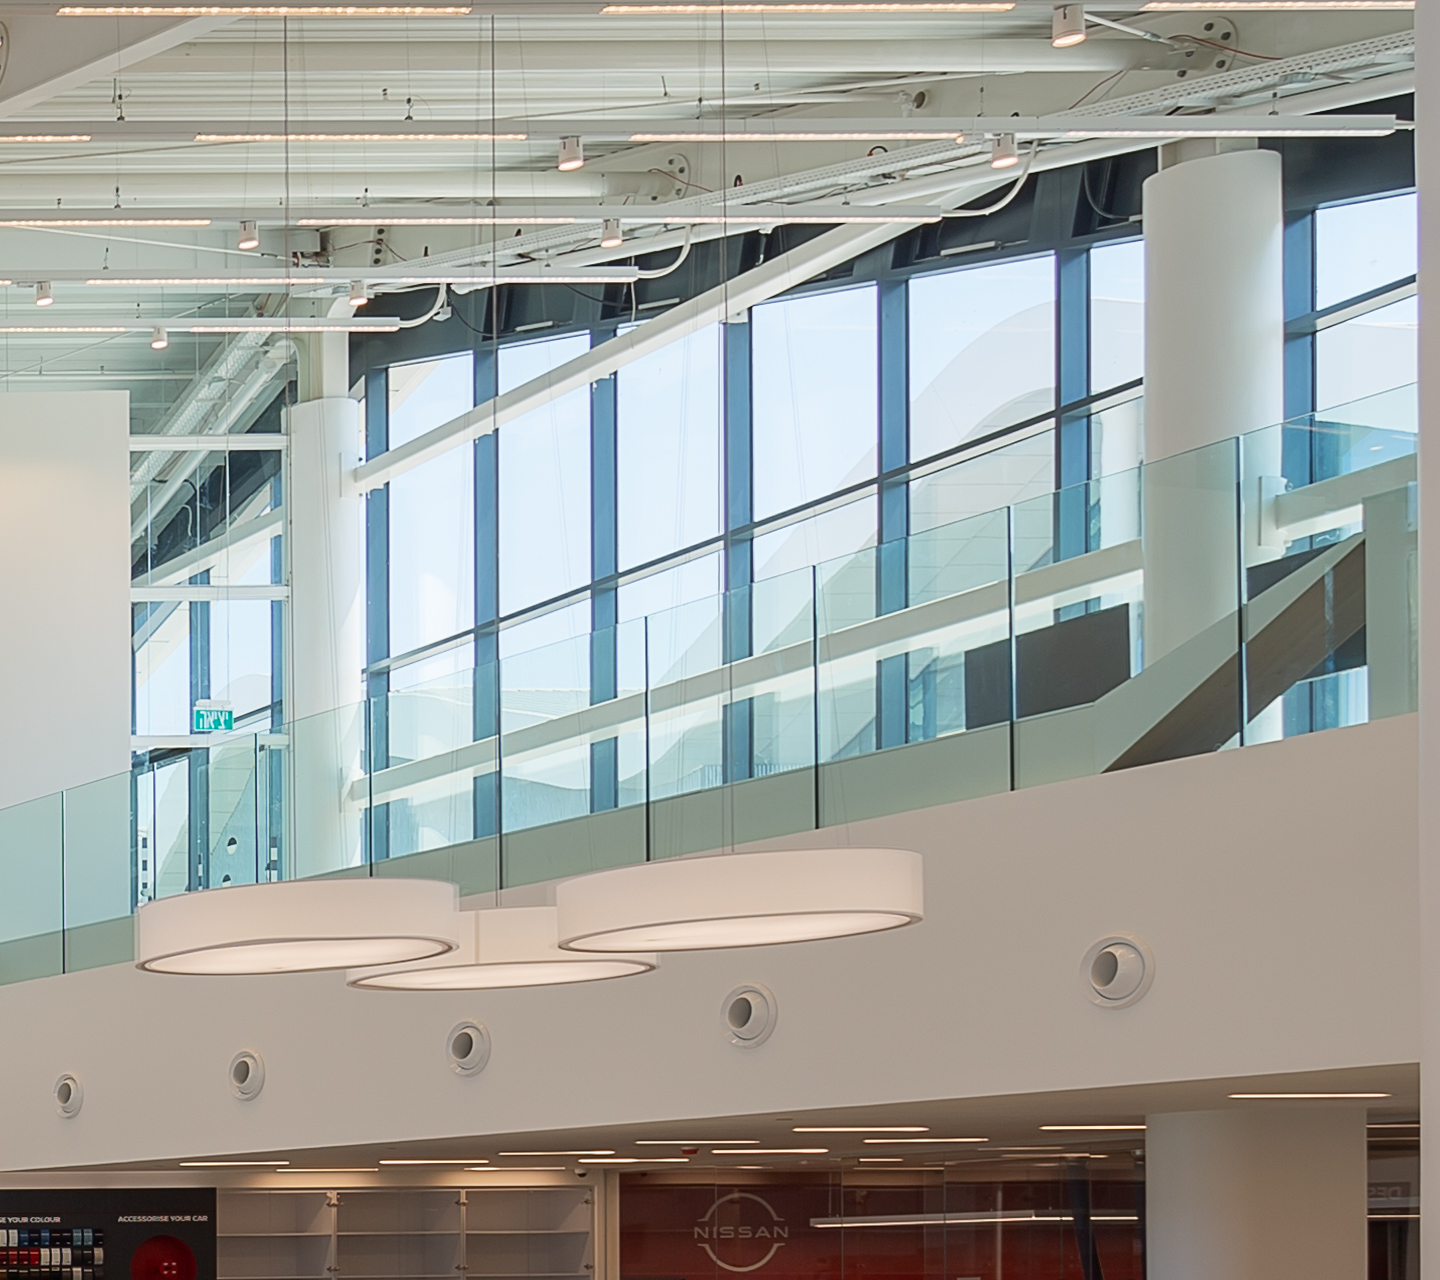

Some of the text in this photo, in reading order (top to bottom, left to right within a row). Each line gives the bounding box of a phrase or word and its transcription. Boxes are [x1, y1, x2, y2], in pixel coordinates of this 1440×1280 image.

[199, 710, 229, 729] יציאה
[7, 1216, 29, 1224] YOUR
[30, 1216, 61, 1224] COLOUR
[117, 1215, 169, 1223] ACCESSORISE
[693, 1225, 789, 1239] NISSAN
